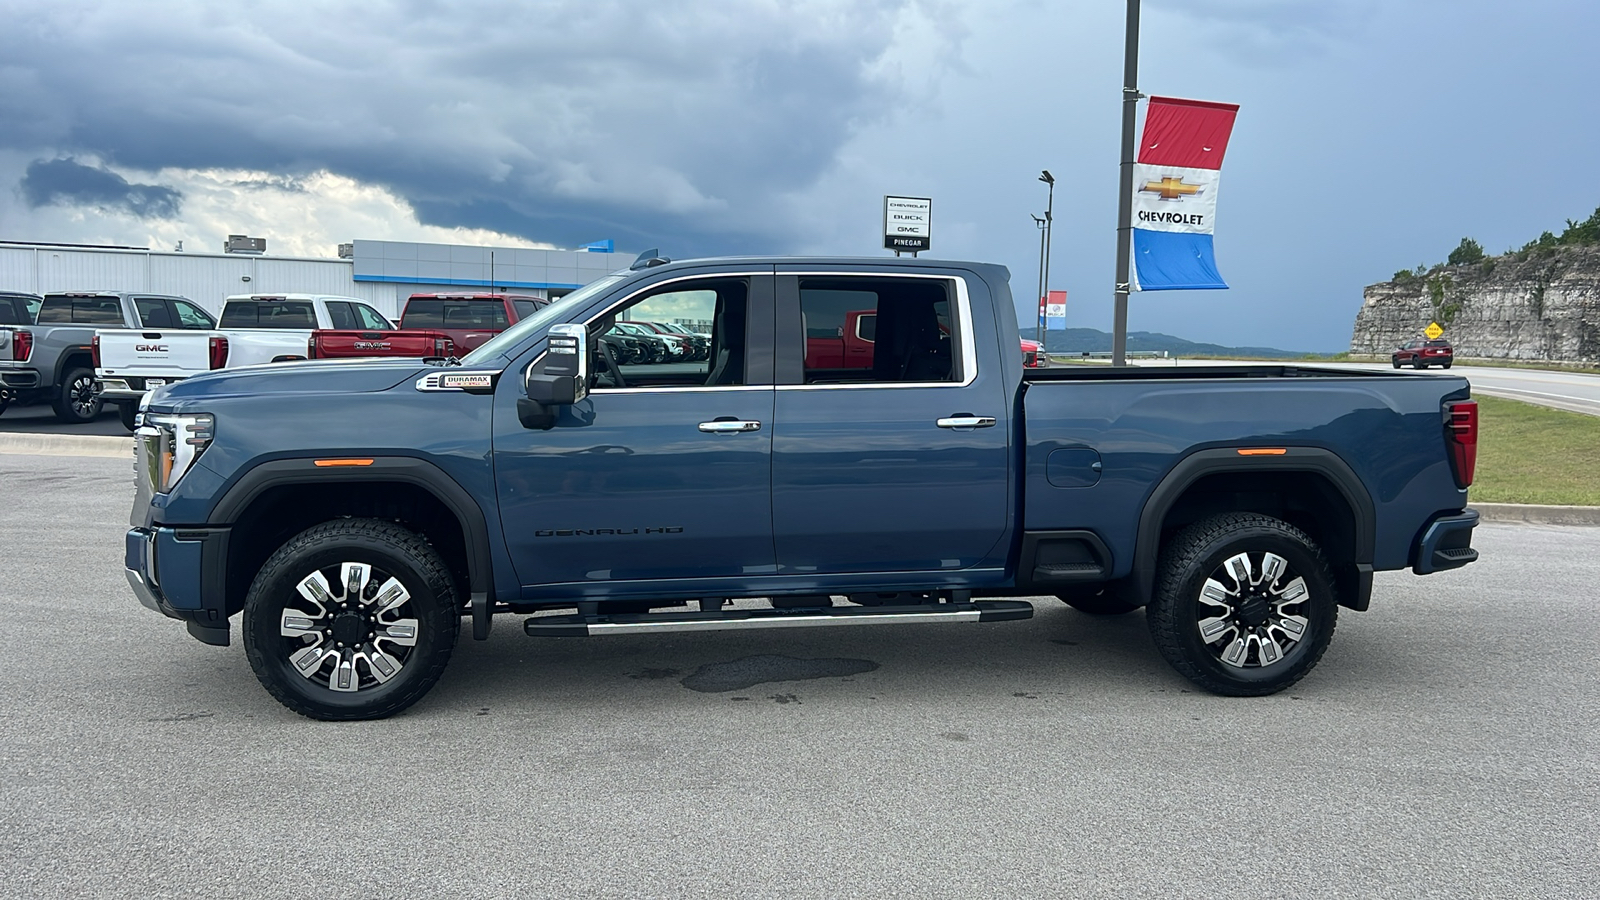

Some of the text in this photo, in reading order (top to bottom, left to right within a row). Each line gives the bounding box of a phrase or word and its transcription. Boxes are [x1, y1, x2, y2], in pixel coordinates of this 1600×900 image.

[1138, 210, 1204, 225] CHEVROLET
[354, 342, 391, 350] GMC
[534, 526, 684, 537] DENALI HD
